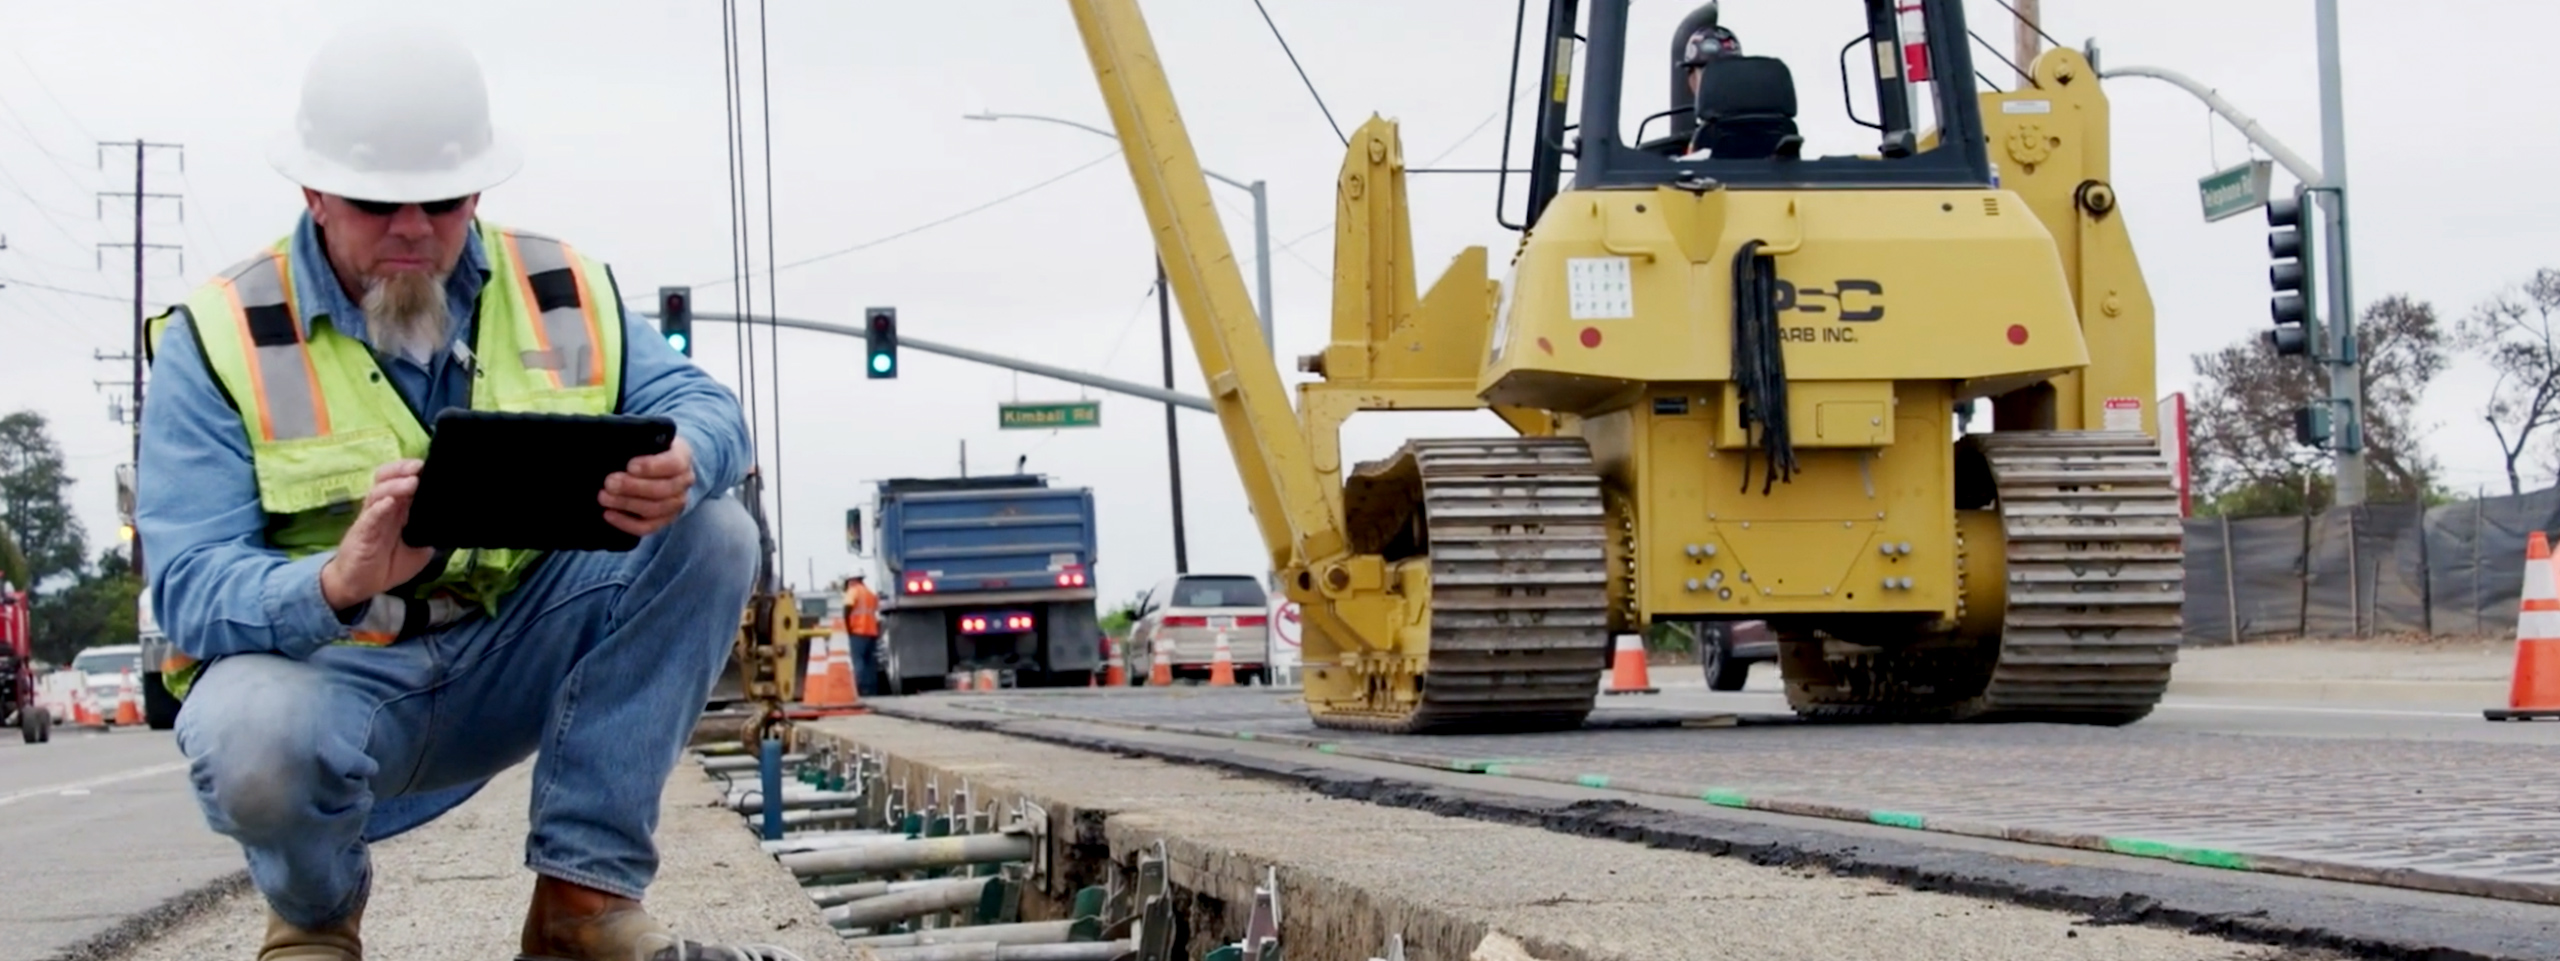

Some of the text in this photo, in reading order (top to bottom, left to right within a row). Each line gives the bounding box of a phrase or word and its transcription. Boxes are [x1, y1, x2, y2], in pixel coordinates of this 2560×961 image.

[1778, 326, 1858, 343] ARB INC.
[1003, 408, 1067, 422] Kimball
